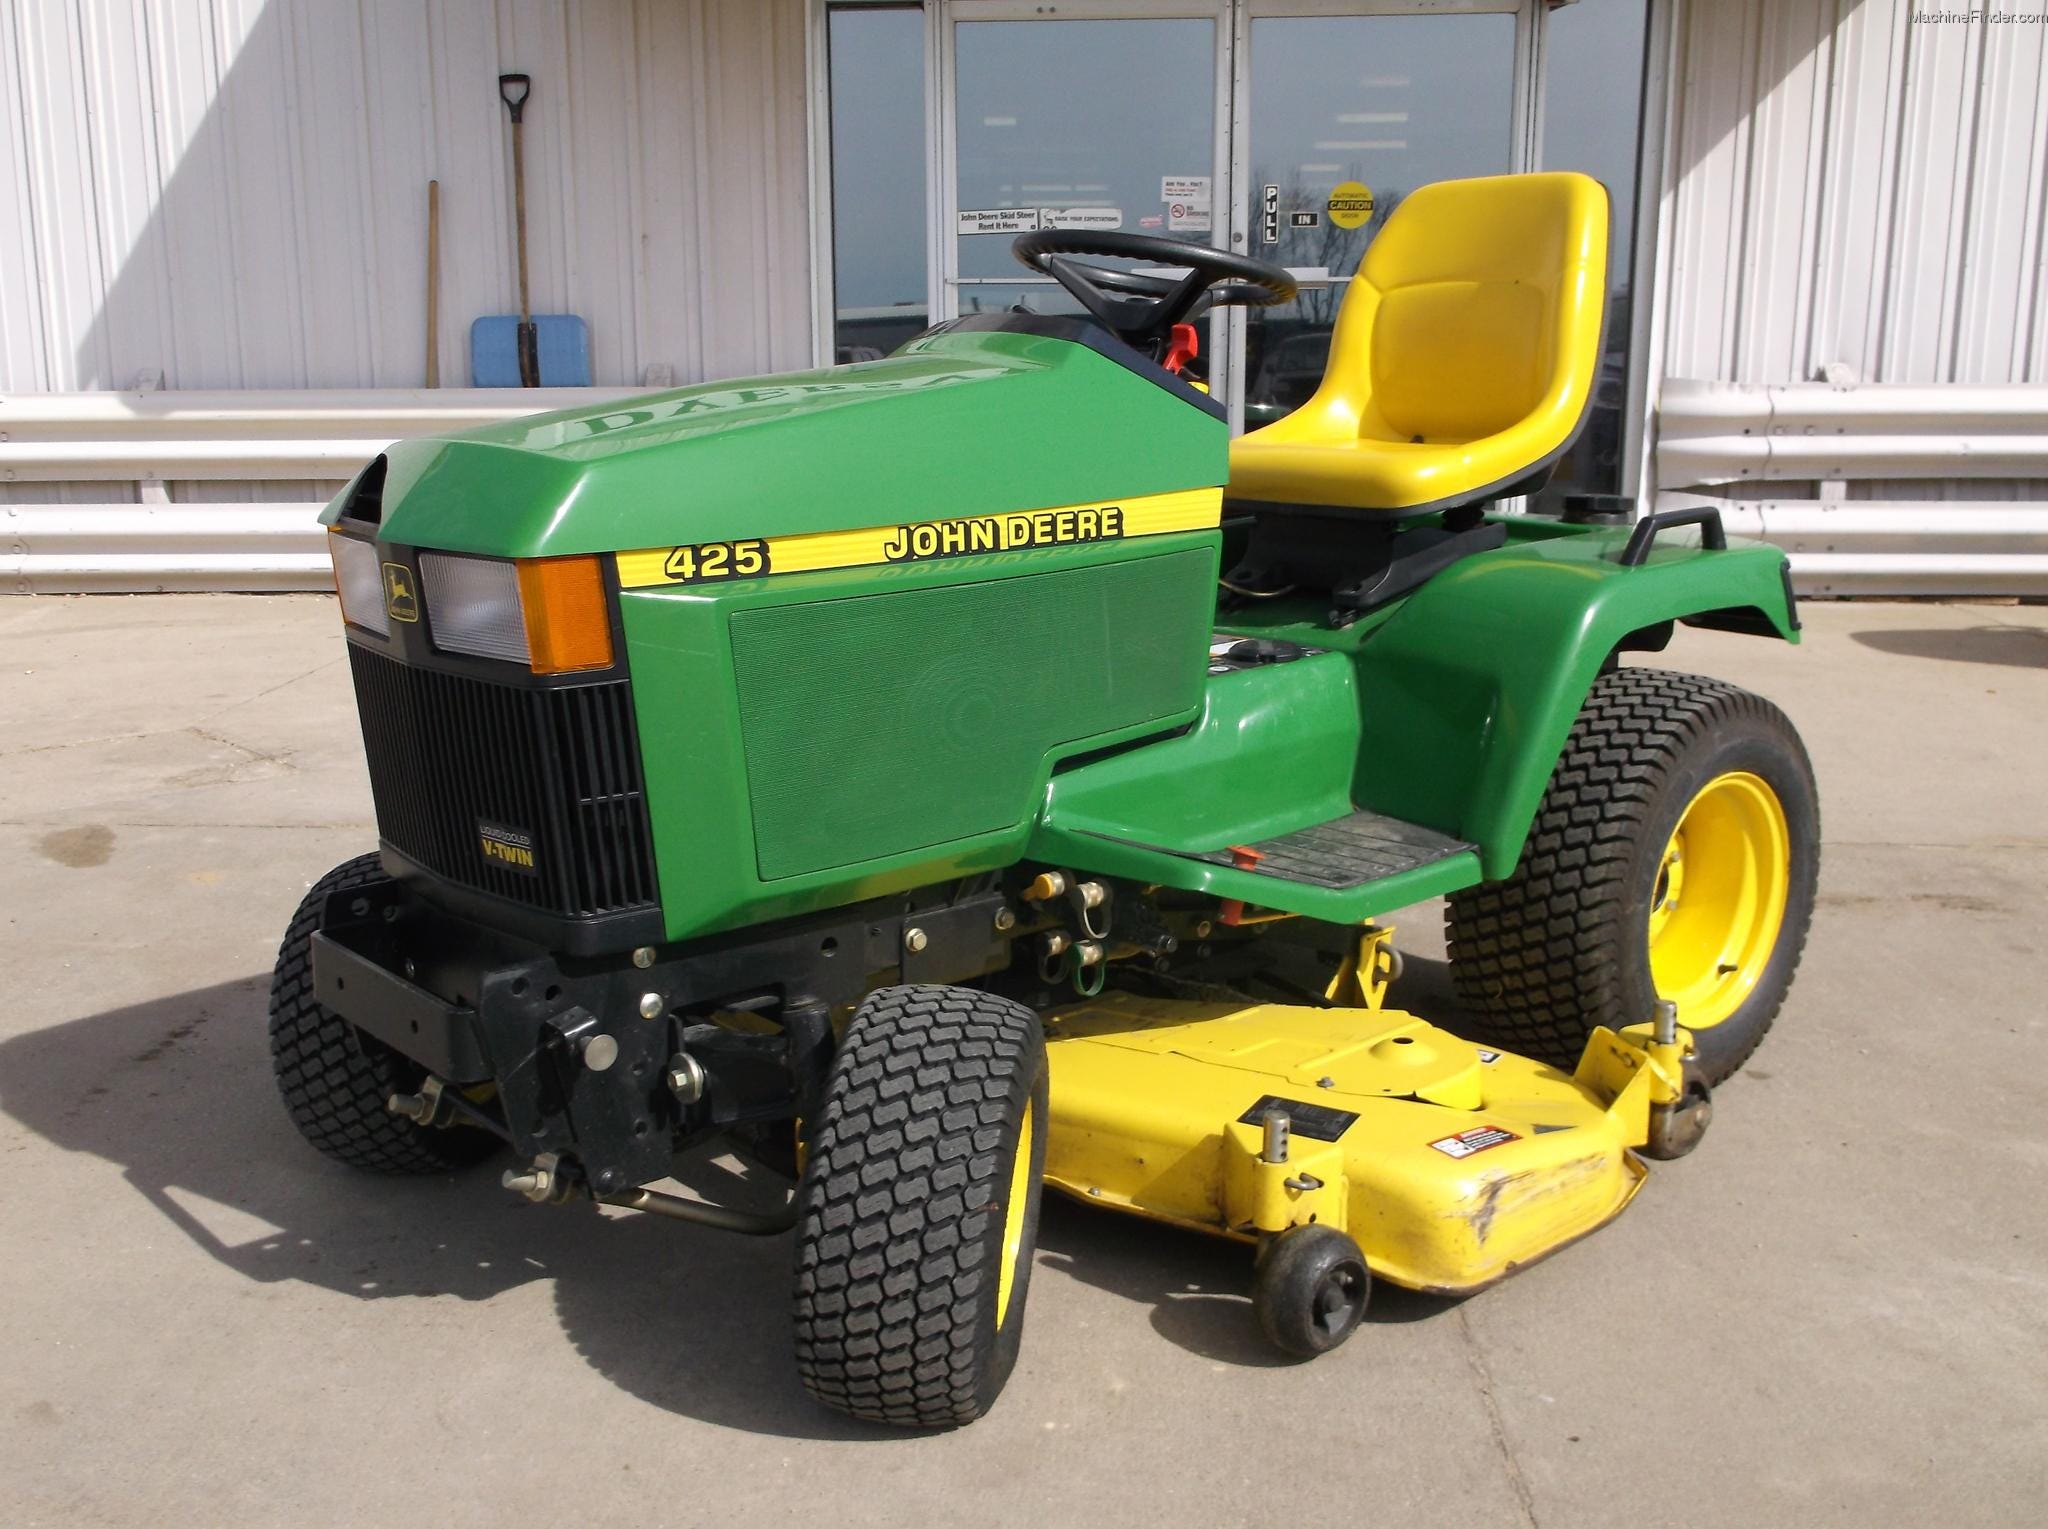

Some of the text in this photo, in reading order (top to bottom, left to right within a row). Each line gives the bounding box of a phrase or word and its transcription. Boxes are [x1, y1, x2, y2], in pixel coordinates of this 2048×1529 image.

[1266, 187, 1277, 241] PULL
[1329, 201, 1372, 210] CAUTION
[961, 210, 1036, 221] John Deere Skid Steer
[1298, 215, 1311, 225] IN
[978, 222, 994, 231] Rent
[1002, 221, 1019, 230] Here
[884, 517, 1001, 562] JOHN
[1007, 507, 1124, 549] DEERE
[665, 539, 771, 580] 425
[482, 839, 533, 867] V-TWIN
